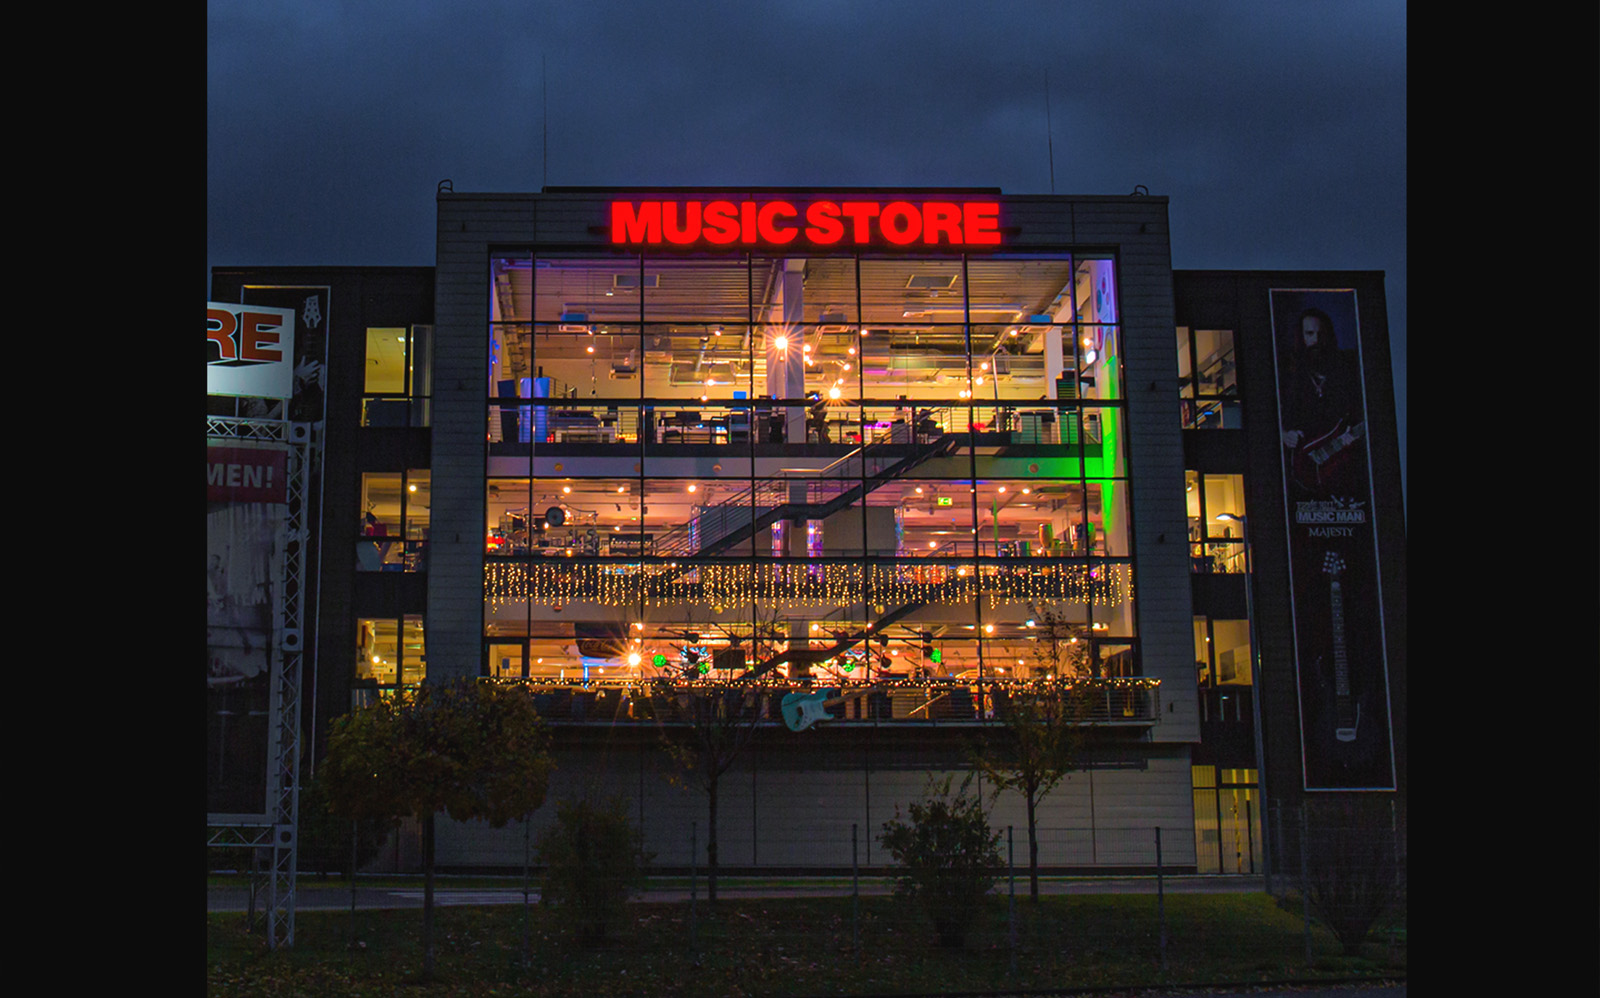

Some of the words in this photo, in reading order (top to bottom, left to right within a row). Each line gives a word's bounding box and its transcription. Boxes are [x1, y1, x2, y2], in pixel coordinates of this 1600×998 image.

[611, 201, 799, 244] MUSIC
[806, 201, 1002, 245] STORE
[1298, 511, 1335, 522] MUSIC
[1336, 511, 1363, 522] MAN
[1308, 527, 1353, 538] MAJESTY
